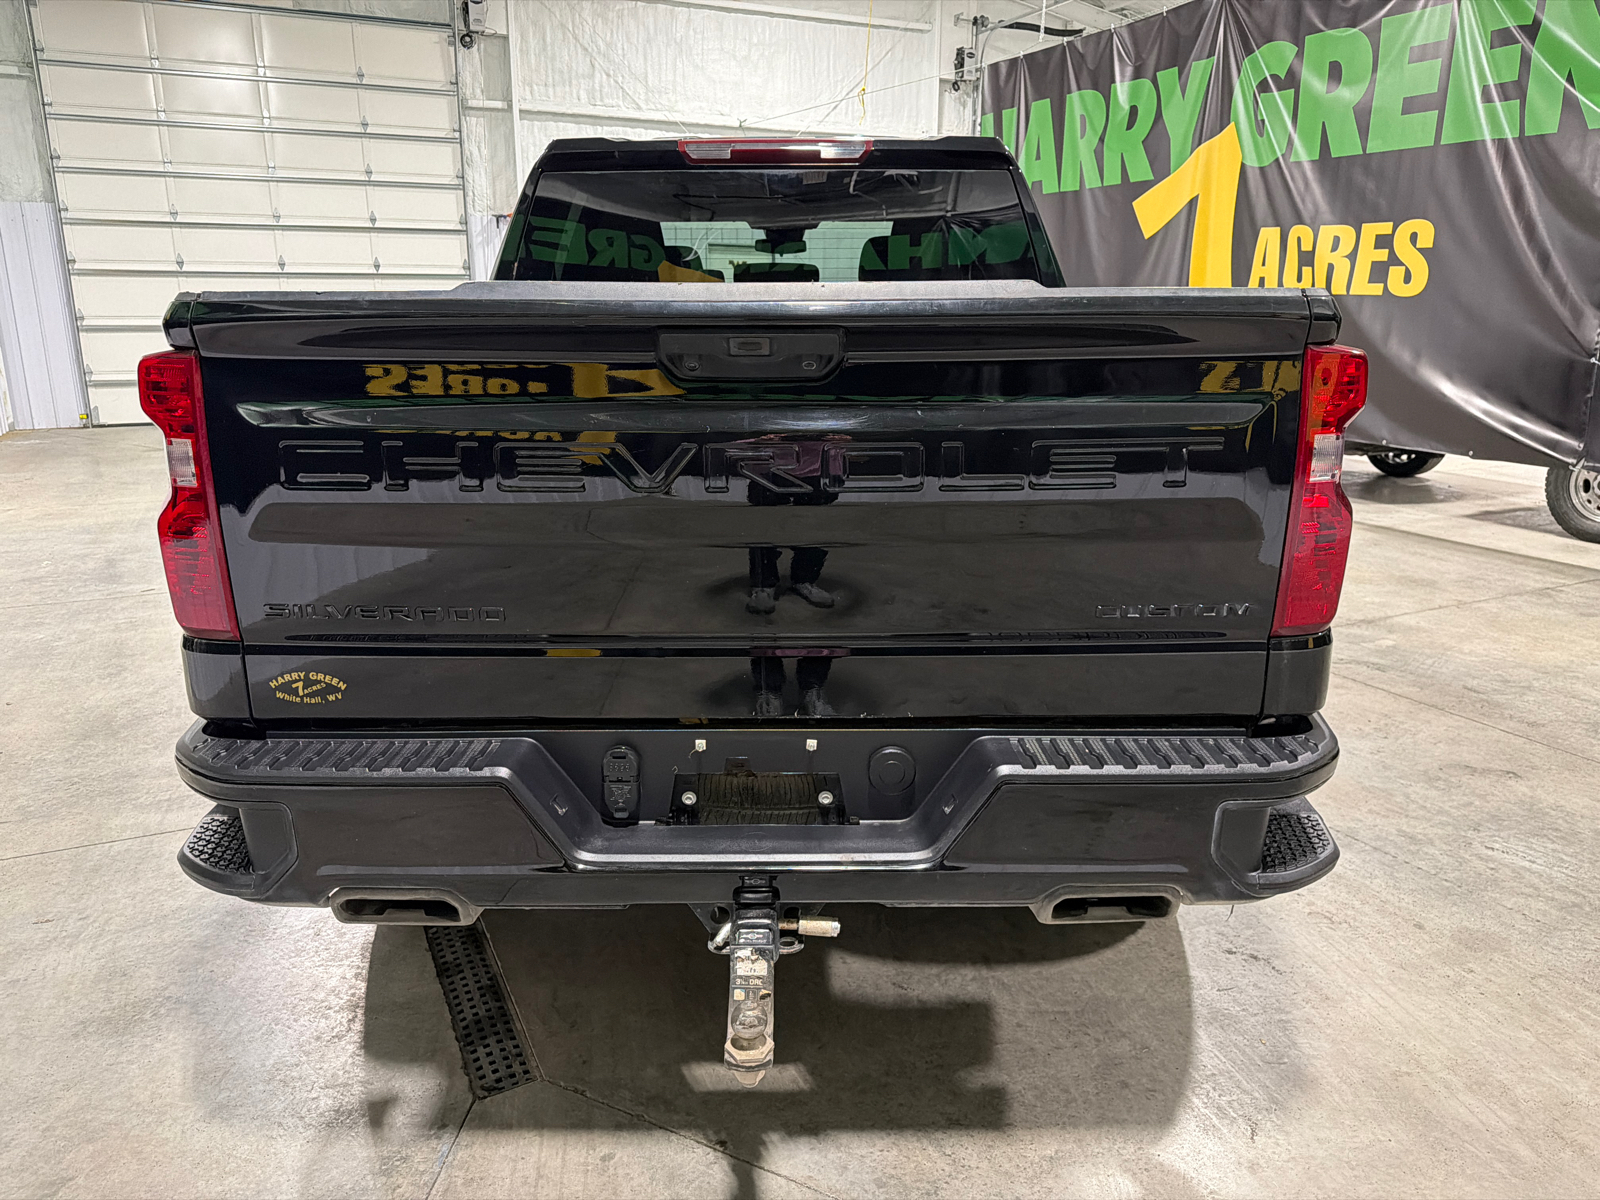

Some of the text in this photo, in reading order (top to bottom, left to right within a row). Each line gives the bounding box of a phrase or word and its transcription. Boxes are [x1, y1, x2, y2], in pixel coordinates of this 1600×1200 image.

[1132, 121, 1434, 297] 7 ACRES
[279, 437, 1225, 493] CHEVROLET
[263, 603, 507, 622] SILVERADO
[1095, 603, 1251, 618] CUSTOM
[269, 671, 347, 691] HARRY GREEN
[291, 681, 327, 696] 7 ACRES
[276, 690, 342, 704] White Hall, WV
